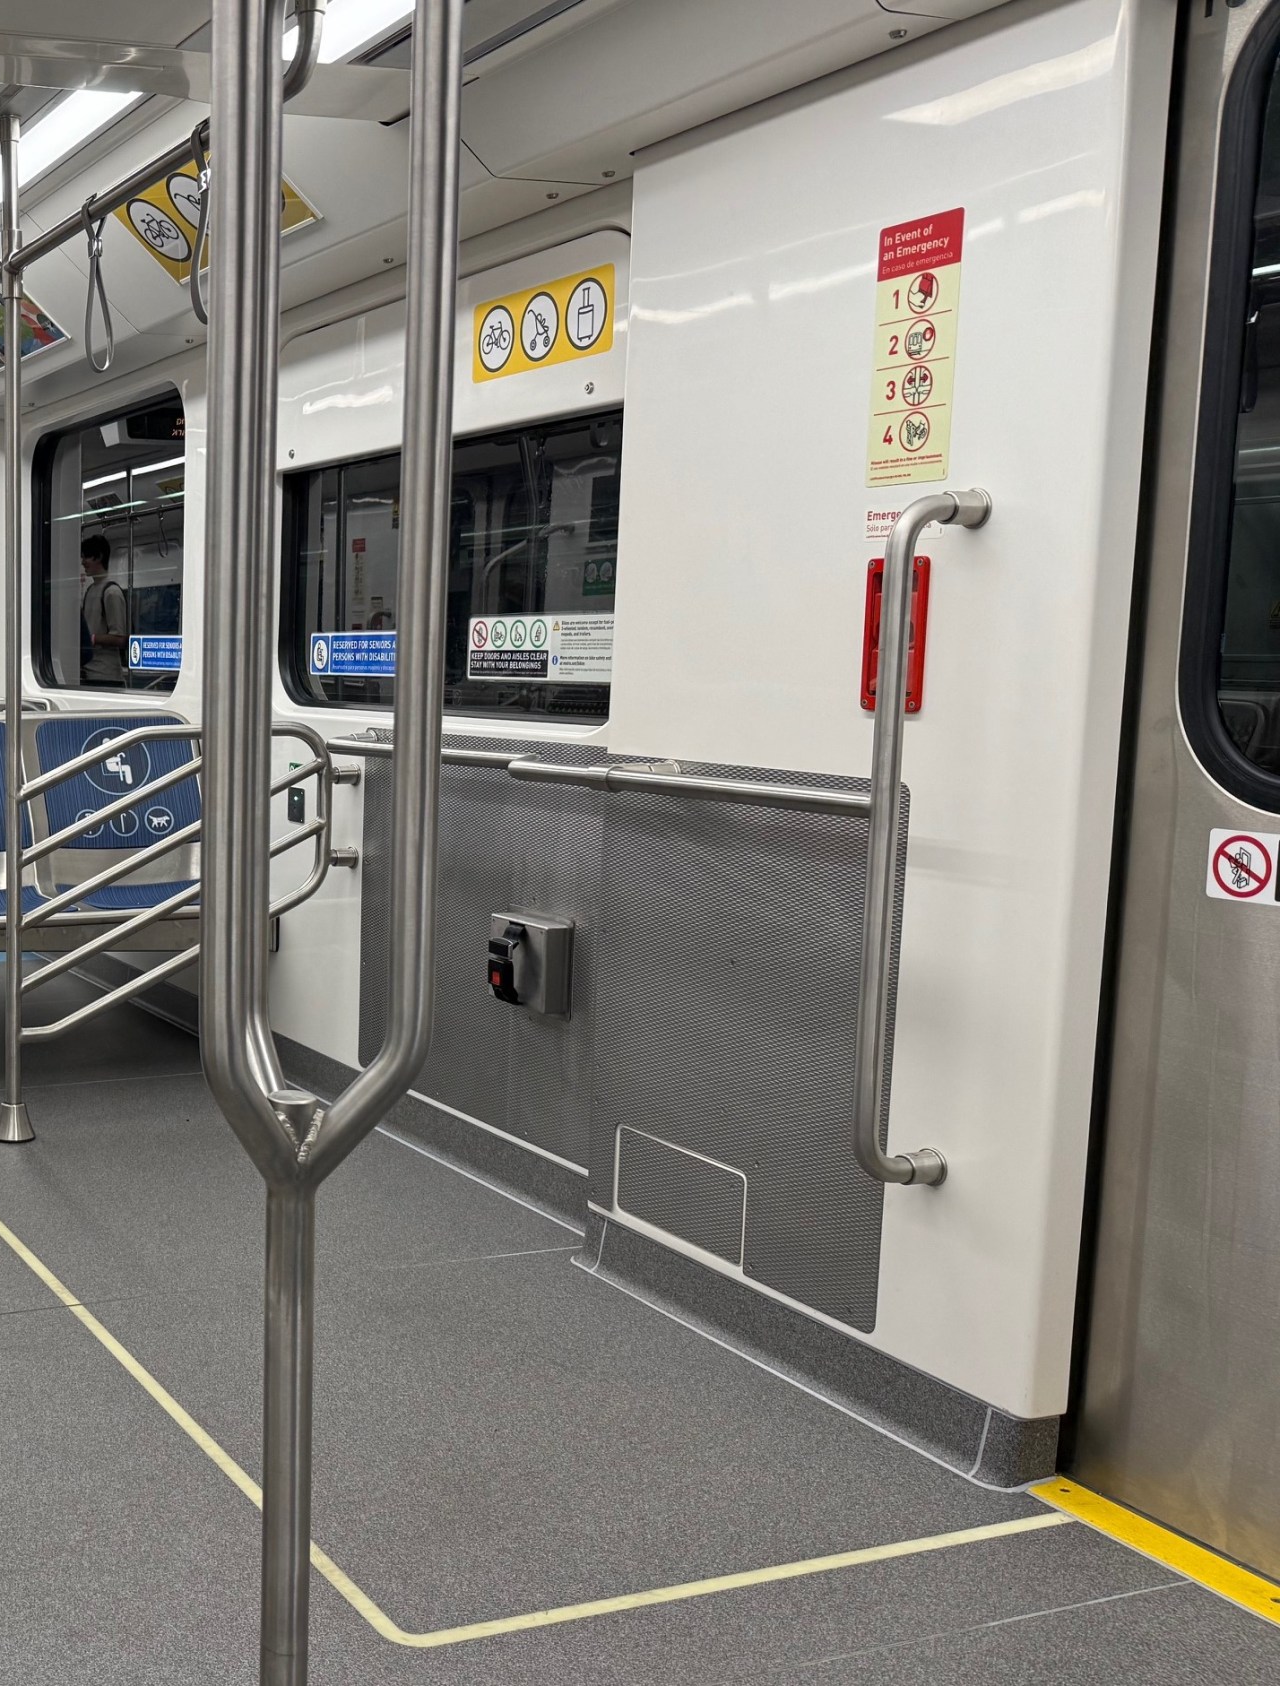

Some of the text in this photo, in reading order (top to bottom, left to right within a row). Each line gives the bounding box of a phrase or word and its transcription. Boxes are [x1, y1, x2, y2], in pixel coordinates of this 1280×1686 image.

[884, 224, 933, 247] In Event of
[883, 237, 950, 261] an Emergency
[891, 264, 905, 272] caso
[907, 261, 915, 269] de
[916, 252, 953, 265] emergencia
[892, 289, 900, 310] 1
[888, 335, 899, 355] 2
[885, 380, 896, 401] 3
[882, 425, 894, 445] 4
[867, 511, 901, 522] Emerge
[333, 641, 357, 649] RESERVED
[359, 641, 368, 649] FOR
[370, 641, 391, 649] SENIORS
